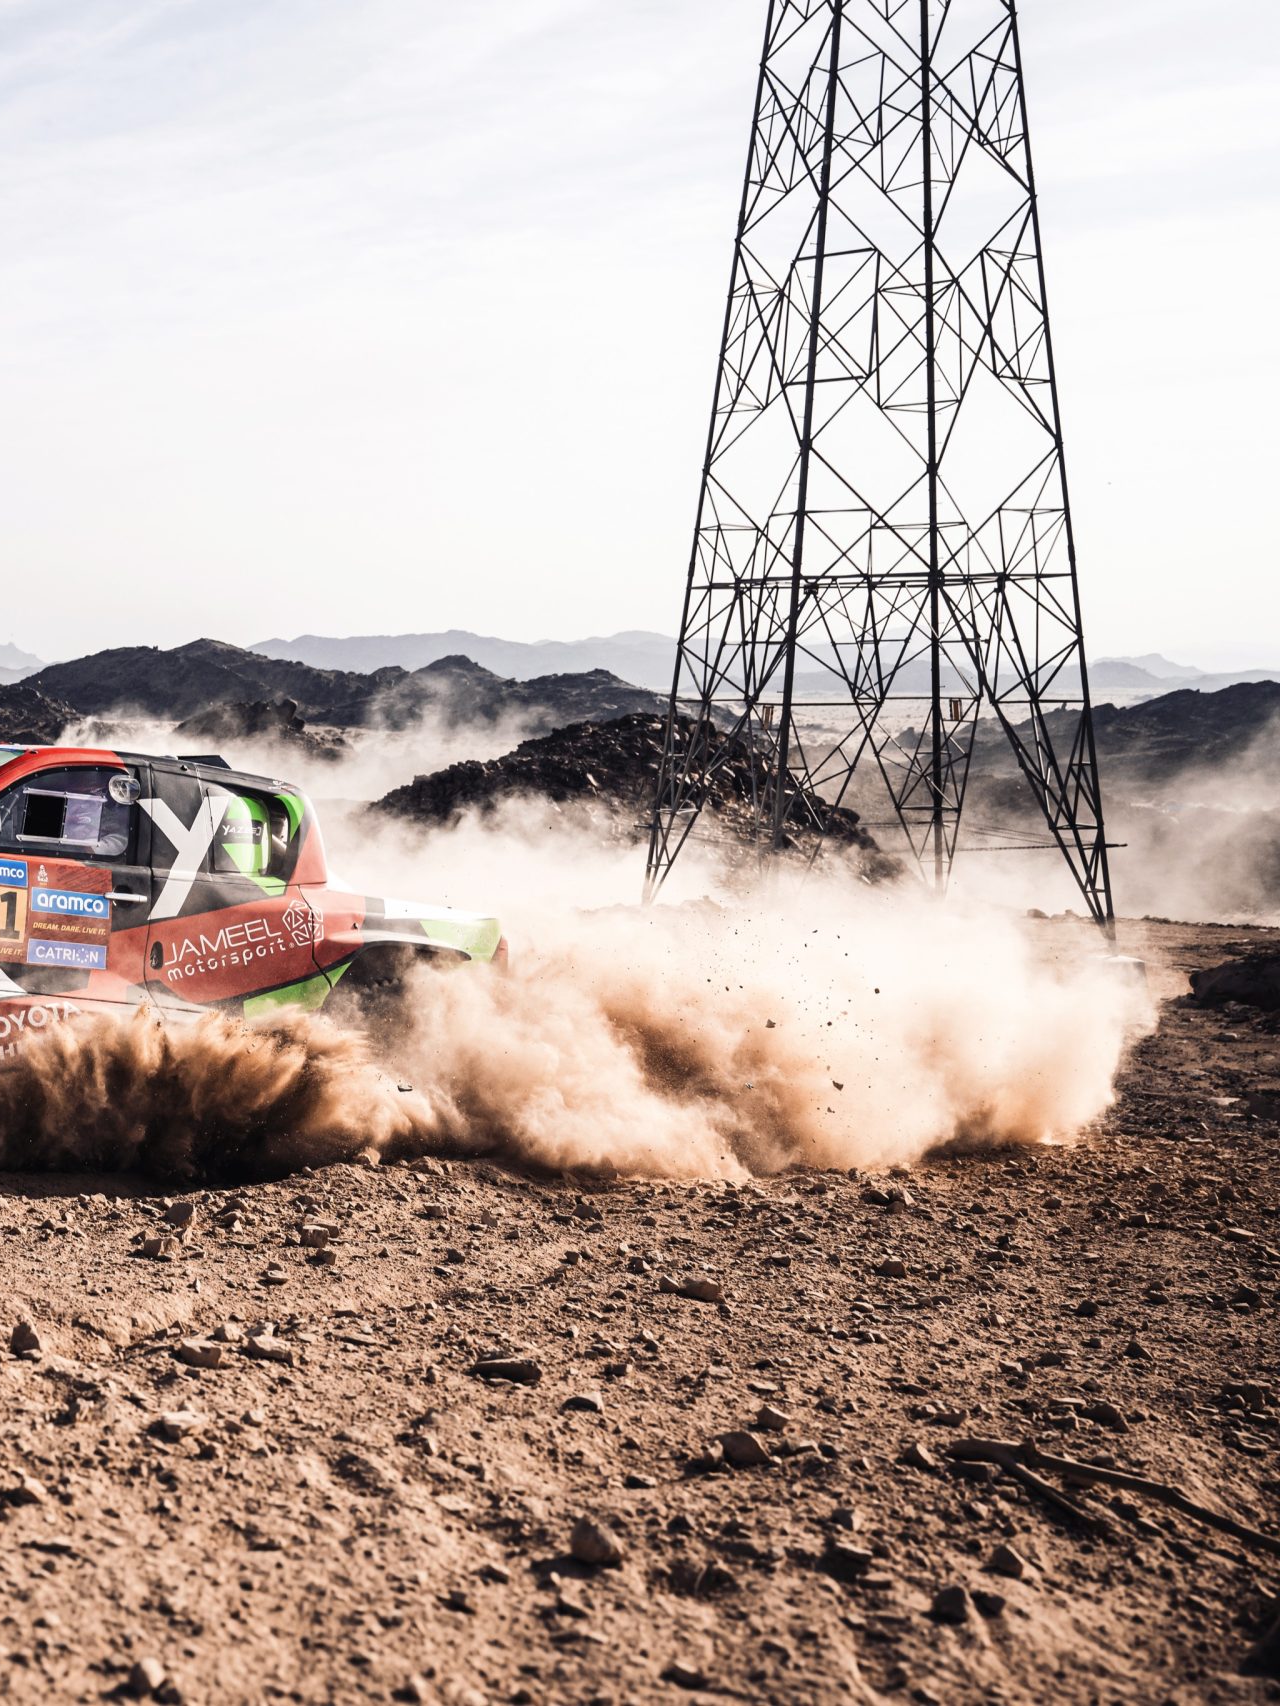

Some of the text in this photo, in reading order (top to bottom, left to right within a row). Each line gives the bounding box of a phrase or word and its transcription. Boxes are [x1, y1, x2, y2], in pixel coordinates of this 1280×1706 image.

[37, 893, 104, 914] aramco
[33, 921, 59, 931] DREAM.
[61, 924, 81, 933] DARE.
[82, 926, 97, 935] LIVE
[164, 919, 282, 966] JAMEEL
[35, 946, 99, 964] CATRION
